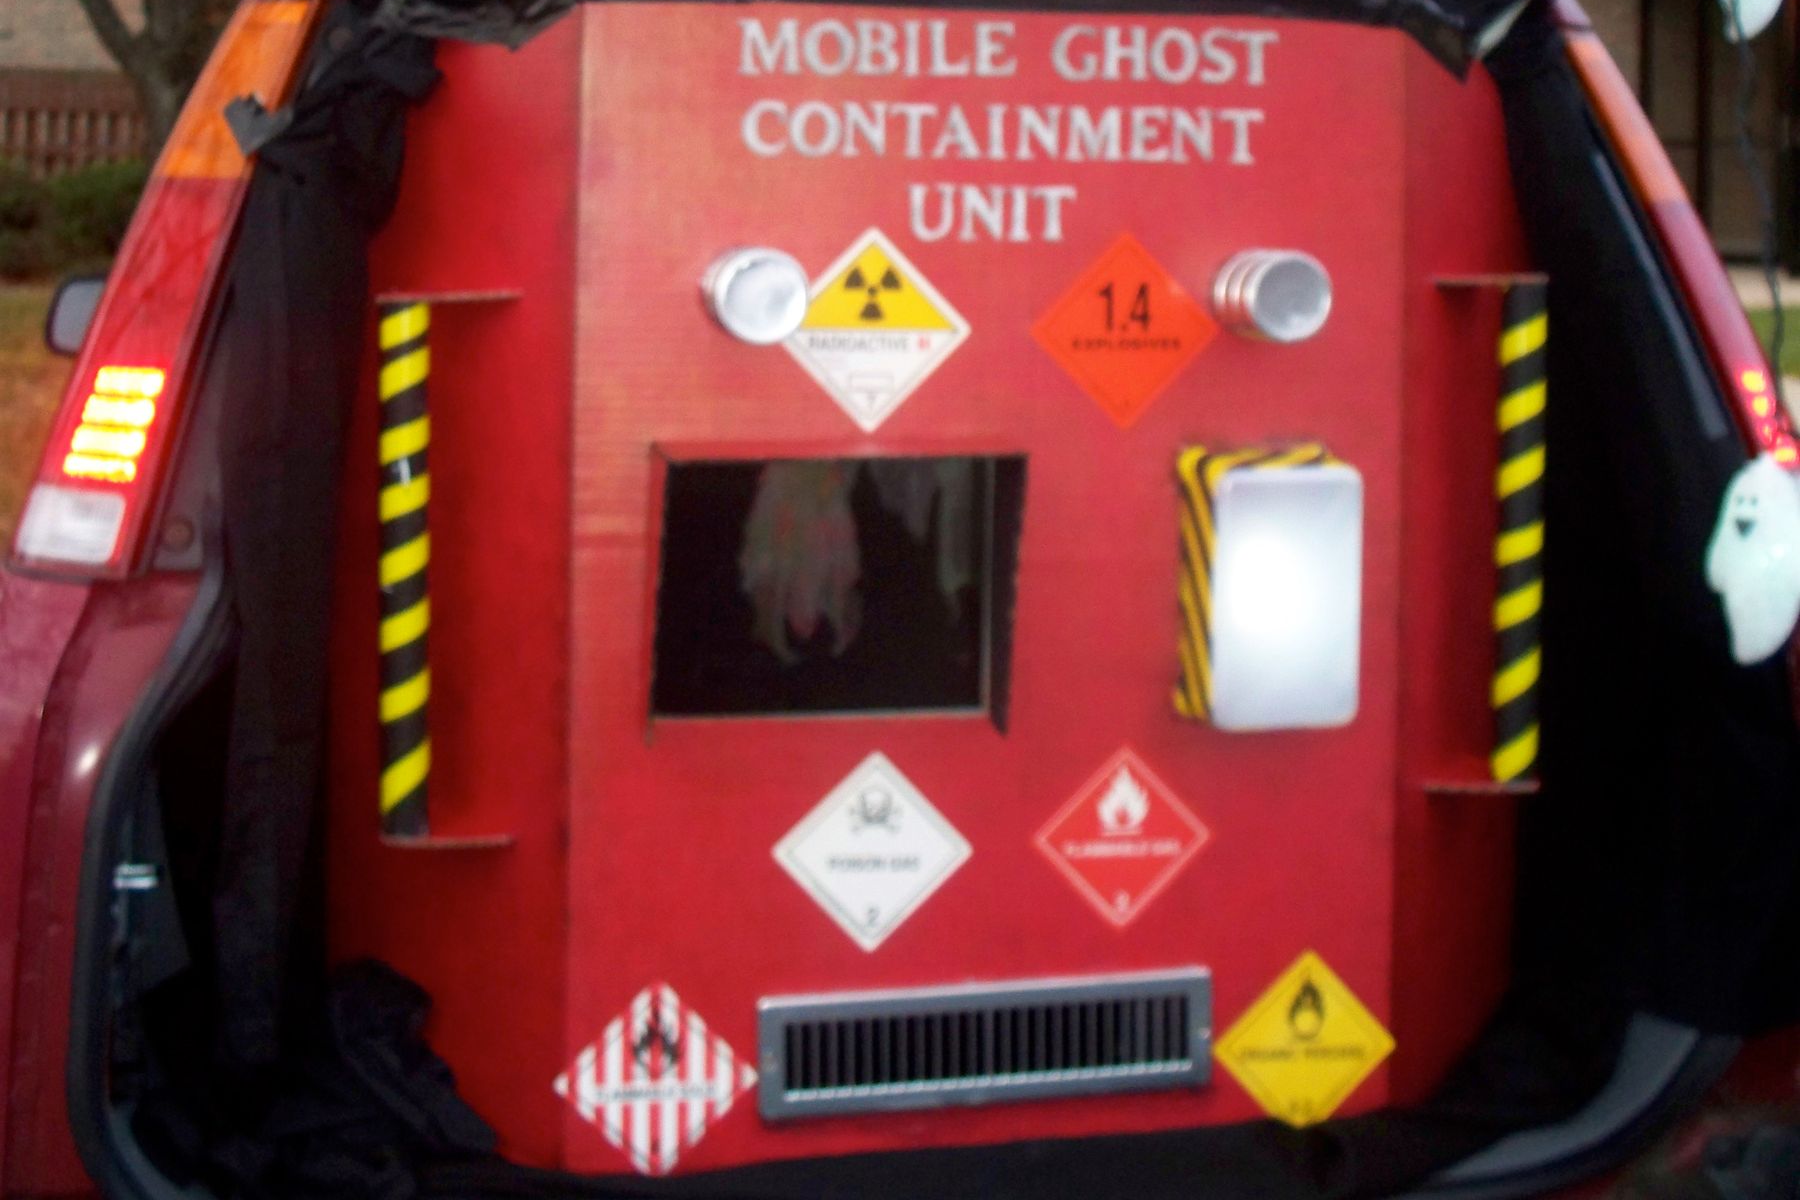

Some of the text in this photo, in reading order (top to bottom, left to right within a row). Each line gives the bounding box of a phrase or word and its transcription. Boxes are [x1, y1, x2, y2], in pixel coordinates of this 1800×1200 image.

[738, 19, 1280, 86] MOBILE GHOST
[741, 101, 1265, 165] CONTAINMENT
[908, 184, 1077, 243] UNIT
[1098, 281, 1151, 332] 1.4
